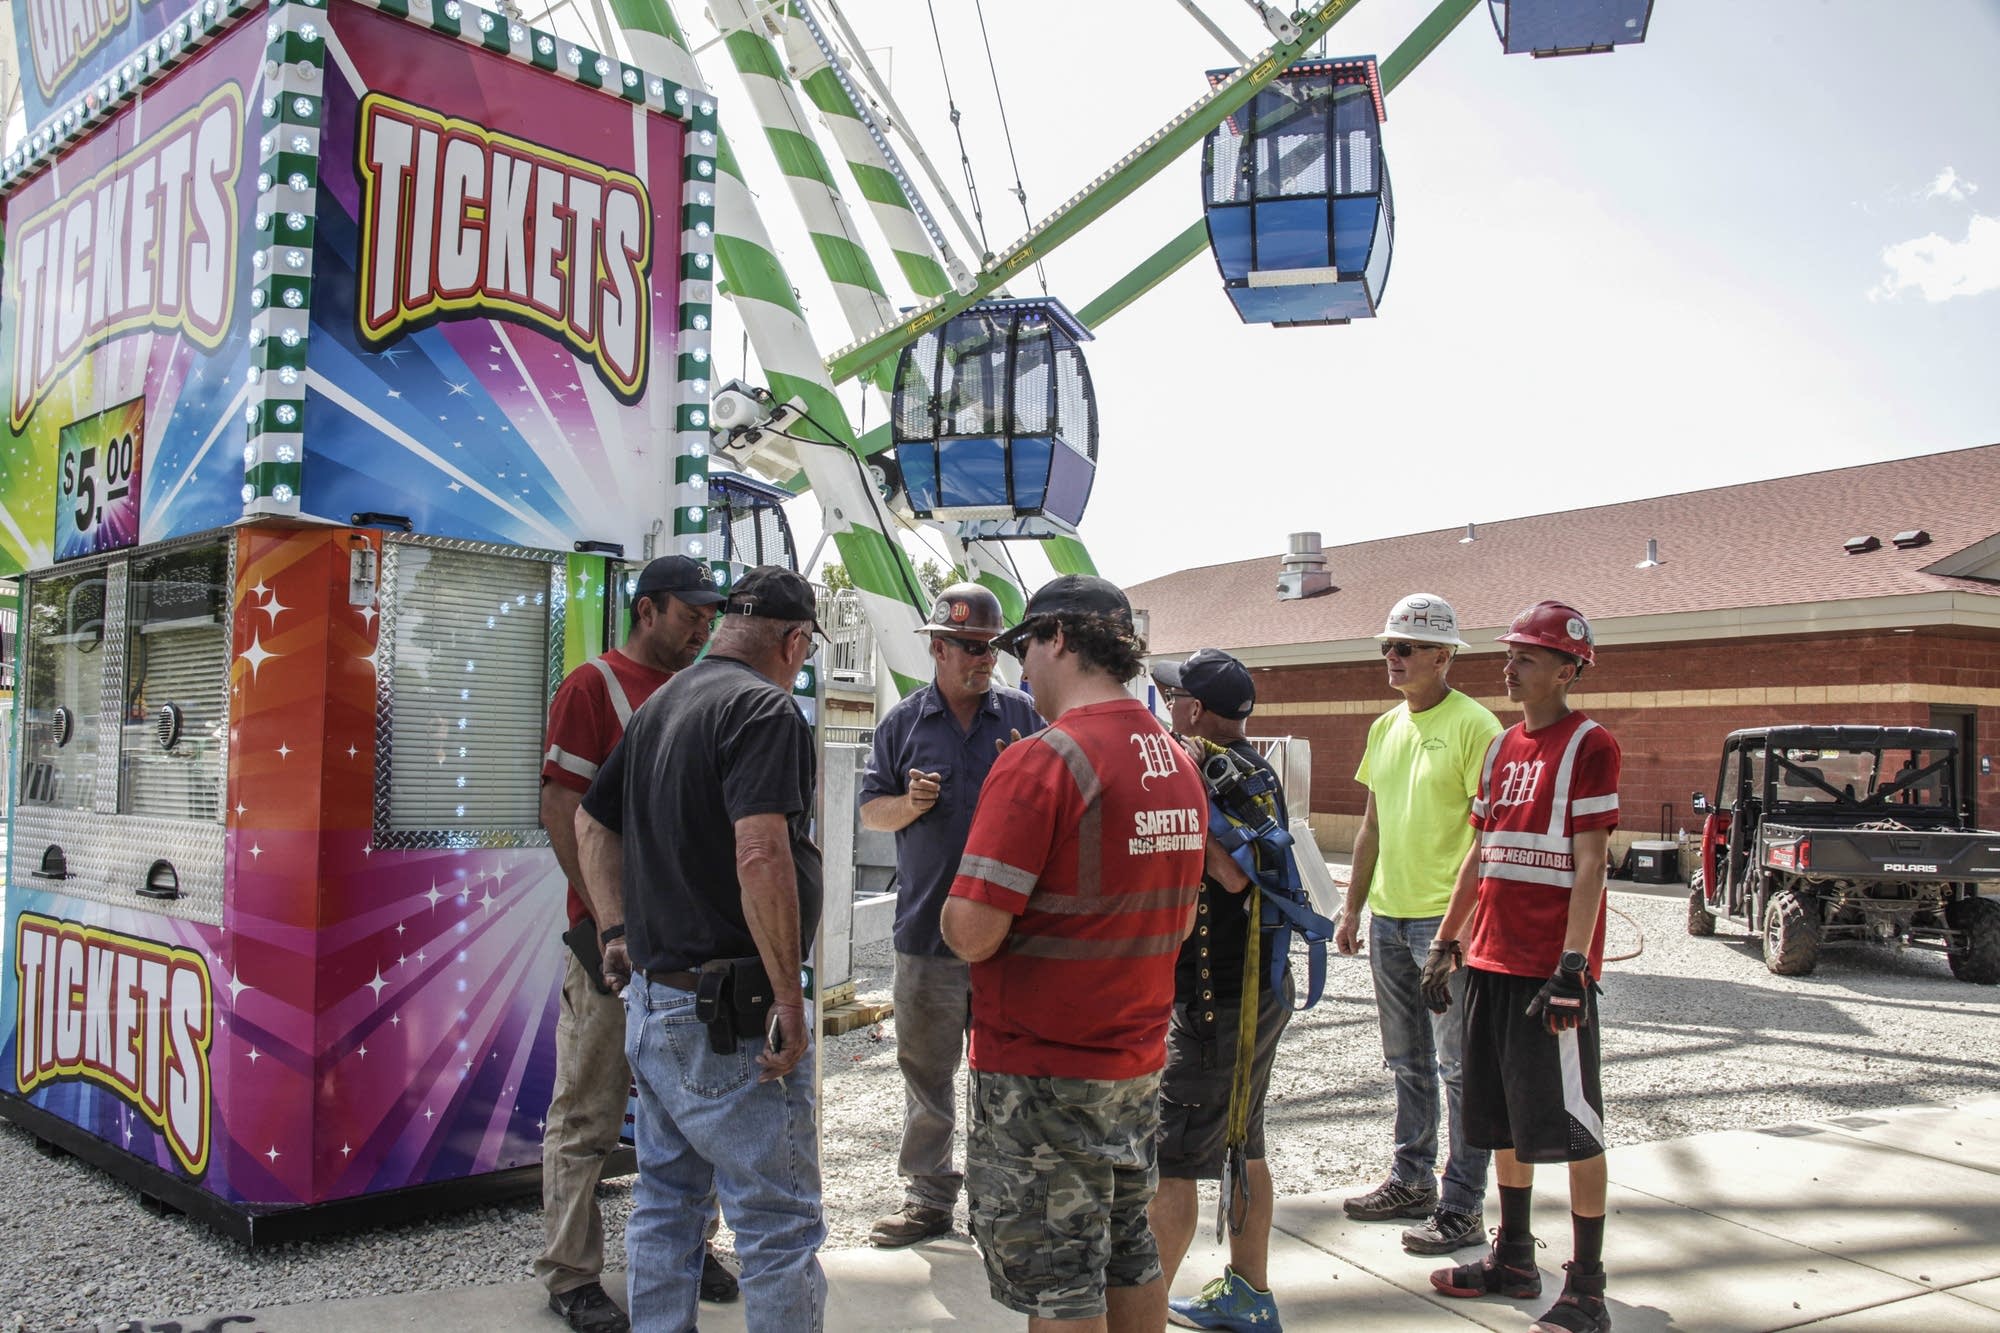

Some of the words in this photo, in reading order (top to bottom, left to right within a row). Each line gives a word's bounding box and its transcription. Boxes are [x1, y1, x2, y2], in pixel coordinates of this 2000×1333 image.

[19, 105, 232, 409] TICKETS
[372, 114, 641, 378] TICKETS
[1134, 808, 1186, 836] SAFETY
[1187, 808, 1200, 833] IS
[1883, 863, 1938, 873] POLARIS
[22, 929, 203, 1158] TICKETS
